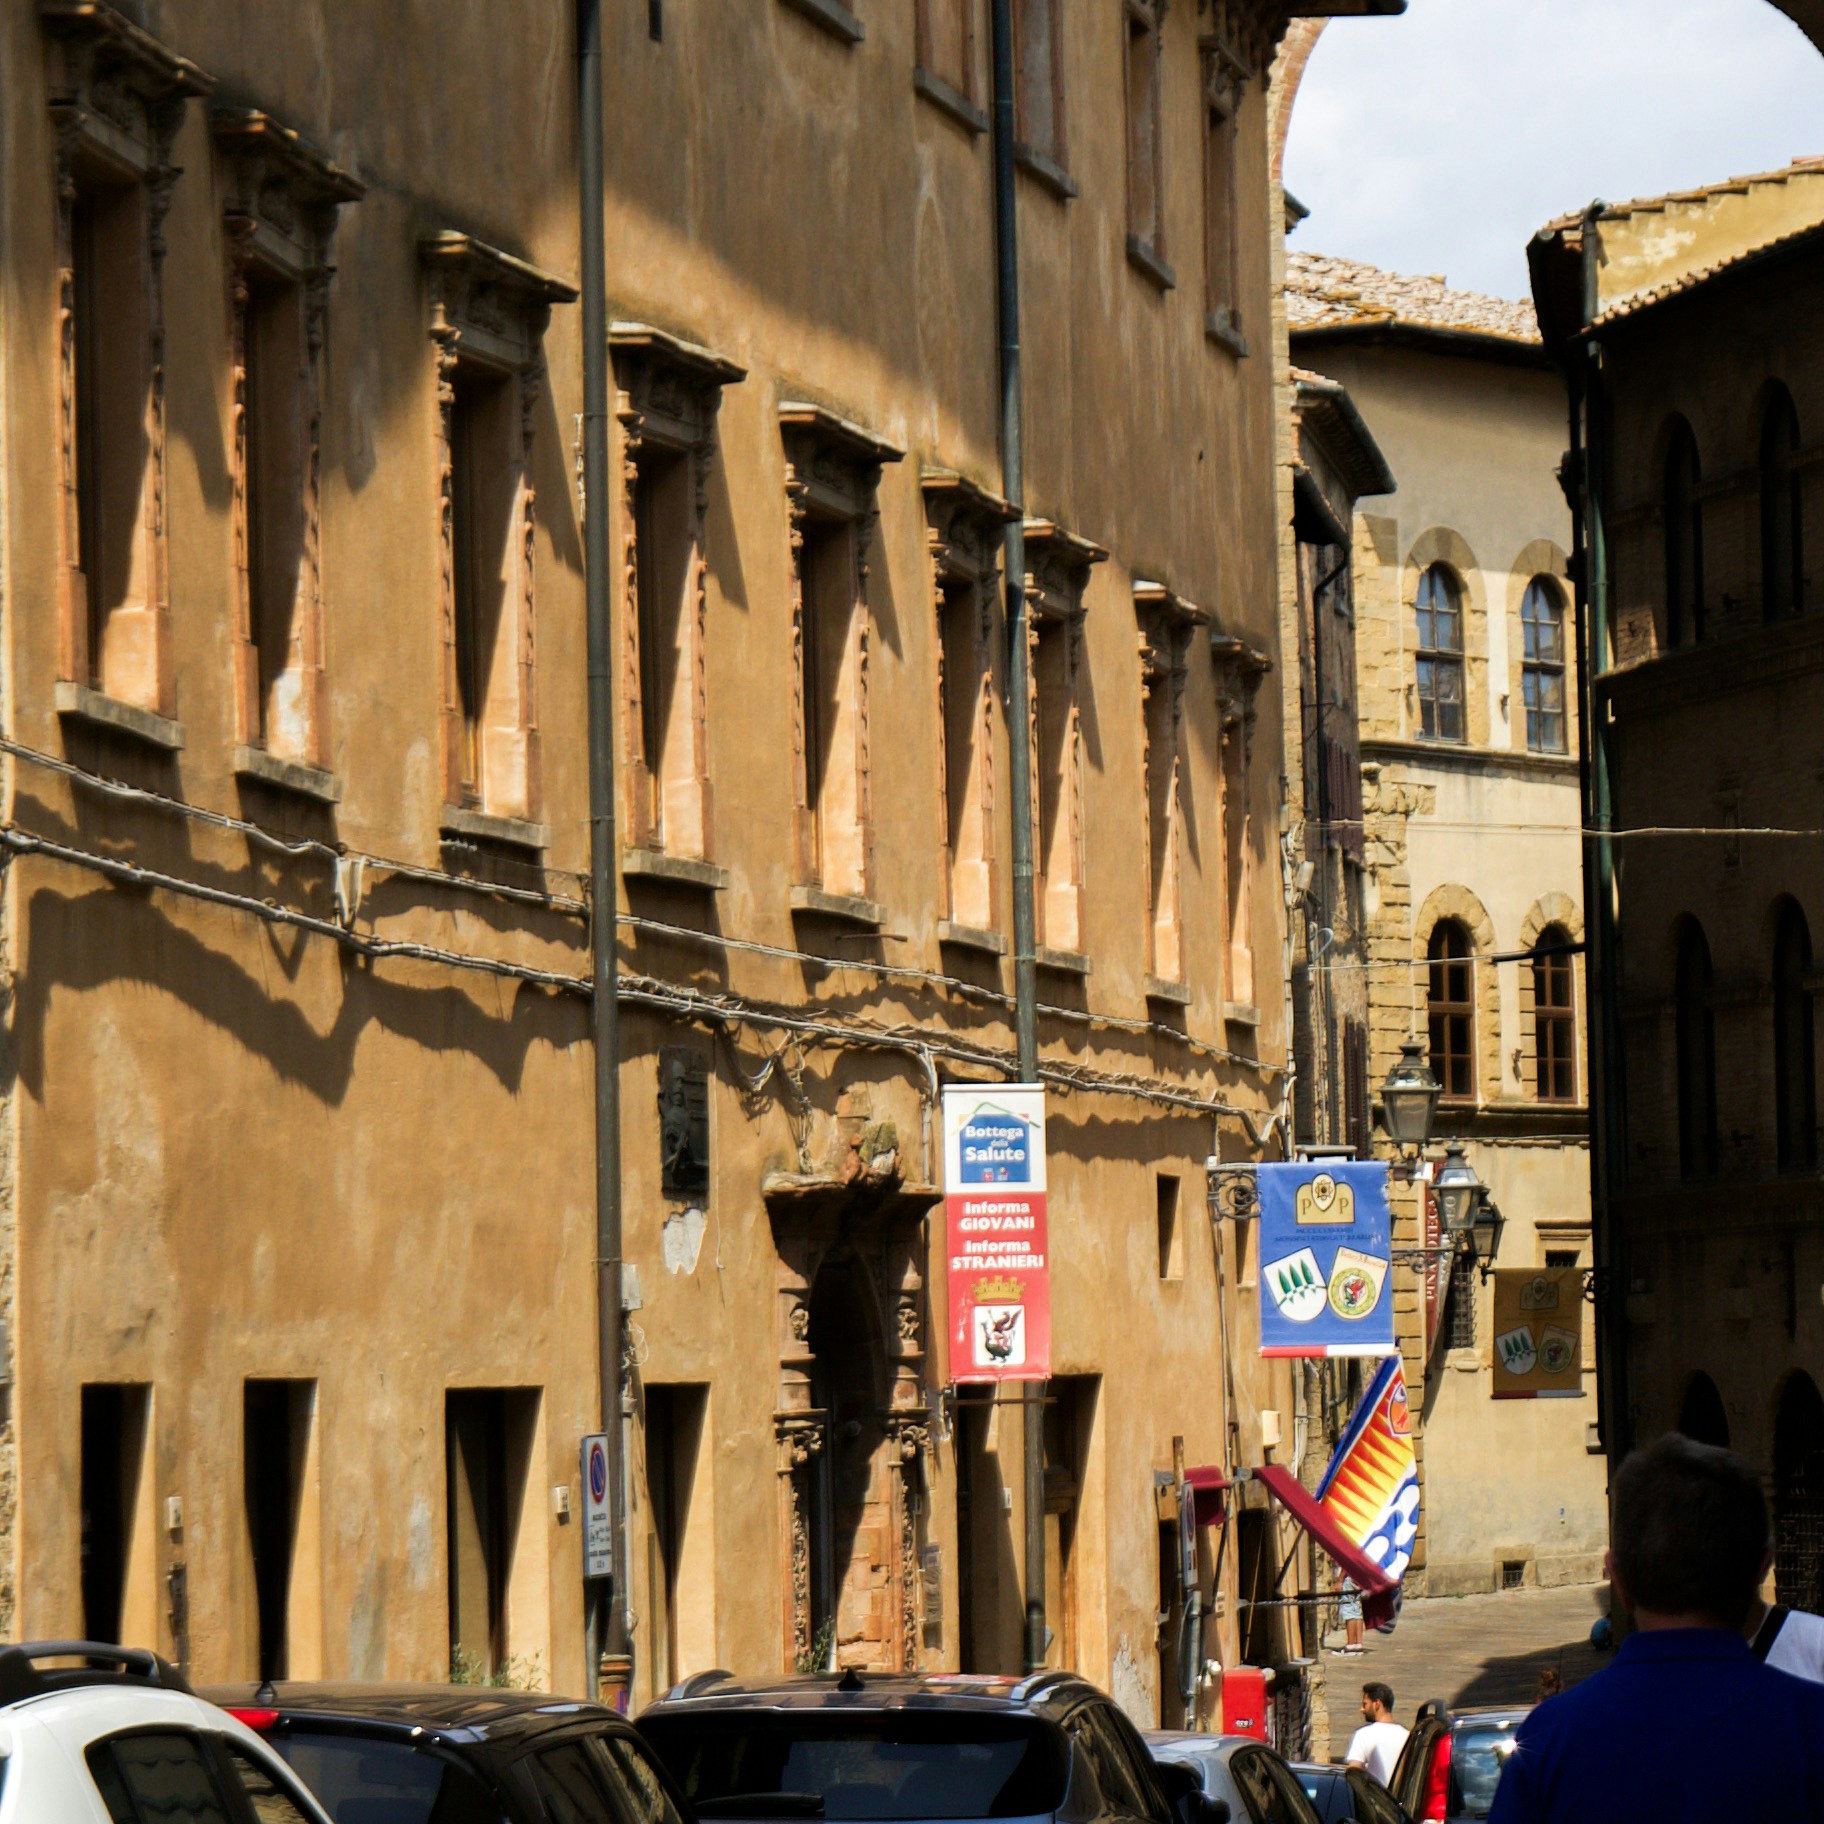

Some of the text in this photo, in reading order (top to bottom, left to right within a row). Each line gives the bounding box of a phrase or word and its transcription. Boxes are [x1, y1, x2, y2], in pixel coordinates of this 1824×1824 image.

[965, 1125, 1024, 1139] Bottega
[965, 1147, 1026, 1162] Salute
[965, 1201, 1030, 1214] Informa
[1302, 1197, 1349, 1215] P P
[960, 1216, 1035, 1231] GIOVANI
[965, 1239, 1031, 1253] Informa
[952, 1254, 1044, 1270] STRANIERI
